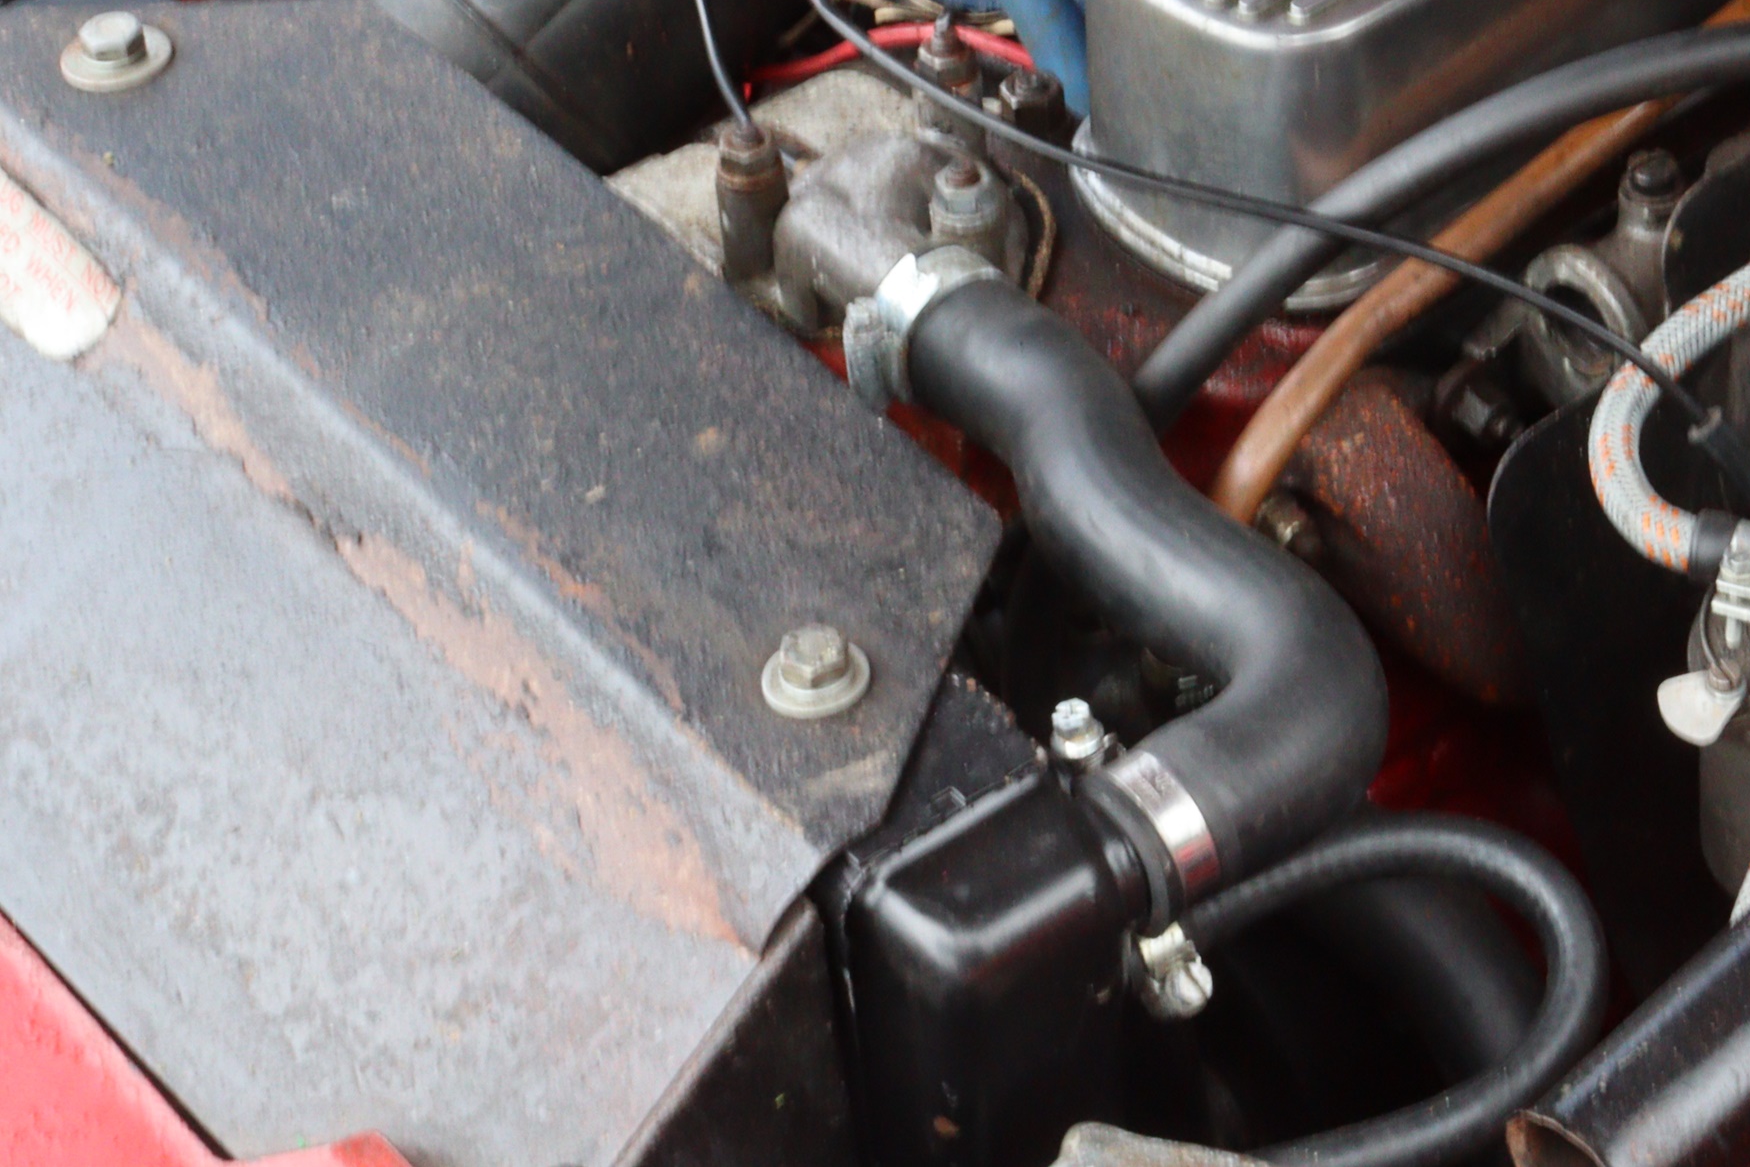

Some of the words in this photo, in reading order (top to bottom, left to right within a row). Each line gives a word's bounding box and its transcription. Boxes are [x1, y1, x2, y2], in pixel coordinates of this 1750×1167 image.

[25, 250, 76, 314] WHEN
[29, 208, 77, 268] MUST
[80, 258, 121, 314] NOT
